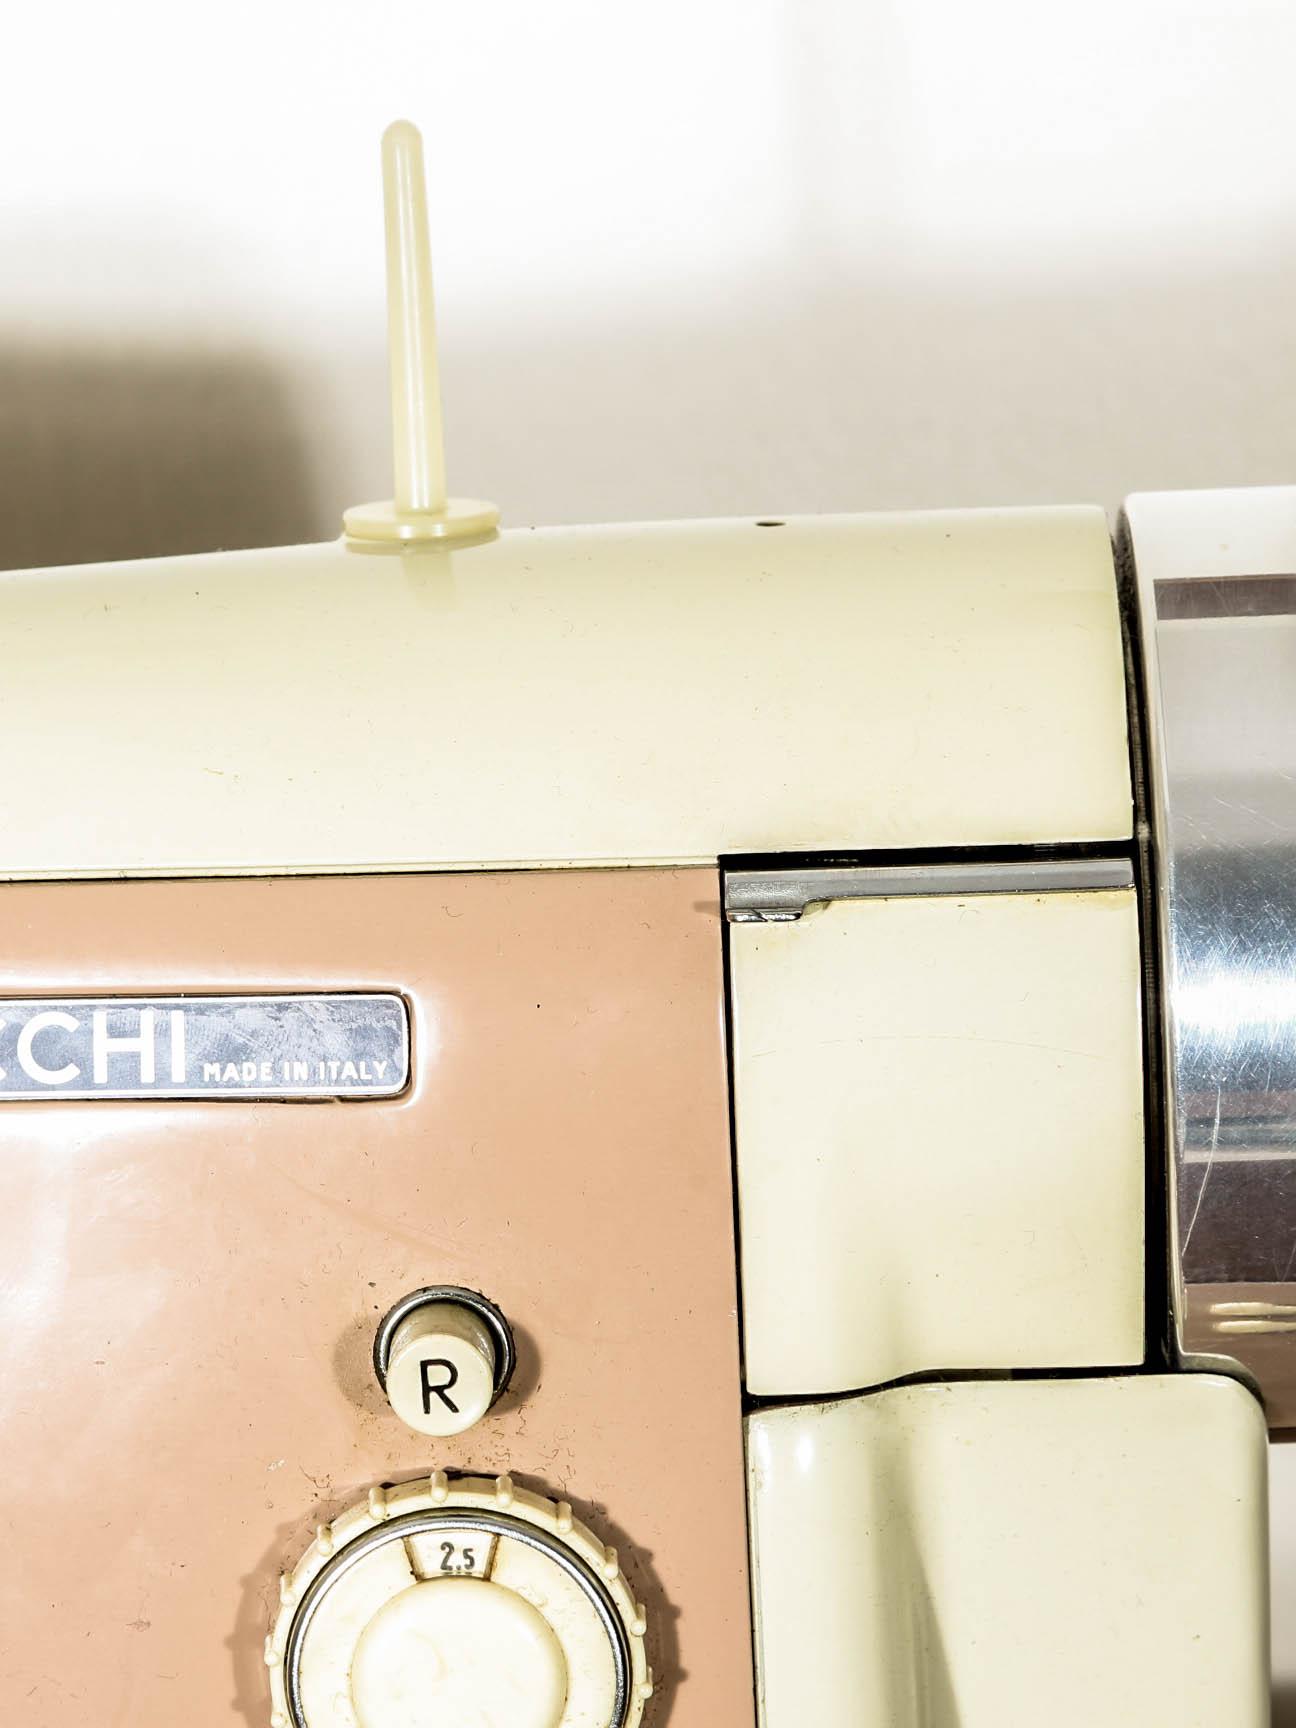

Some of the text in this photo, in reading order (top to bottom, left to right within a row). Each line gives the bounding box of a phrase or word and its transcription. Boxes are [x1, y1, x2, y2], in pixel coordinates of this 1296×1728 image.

[203, 1059, 389, 1082] MADE IN ITALY
[419, 1358, 460, 1415] R
[439, 1541, 476, 1572] 2.5
